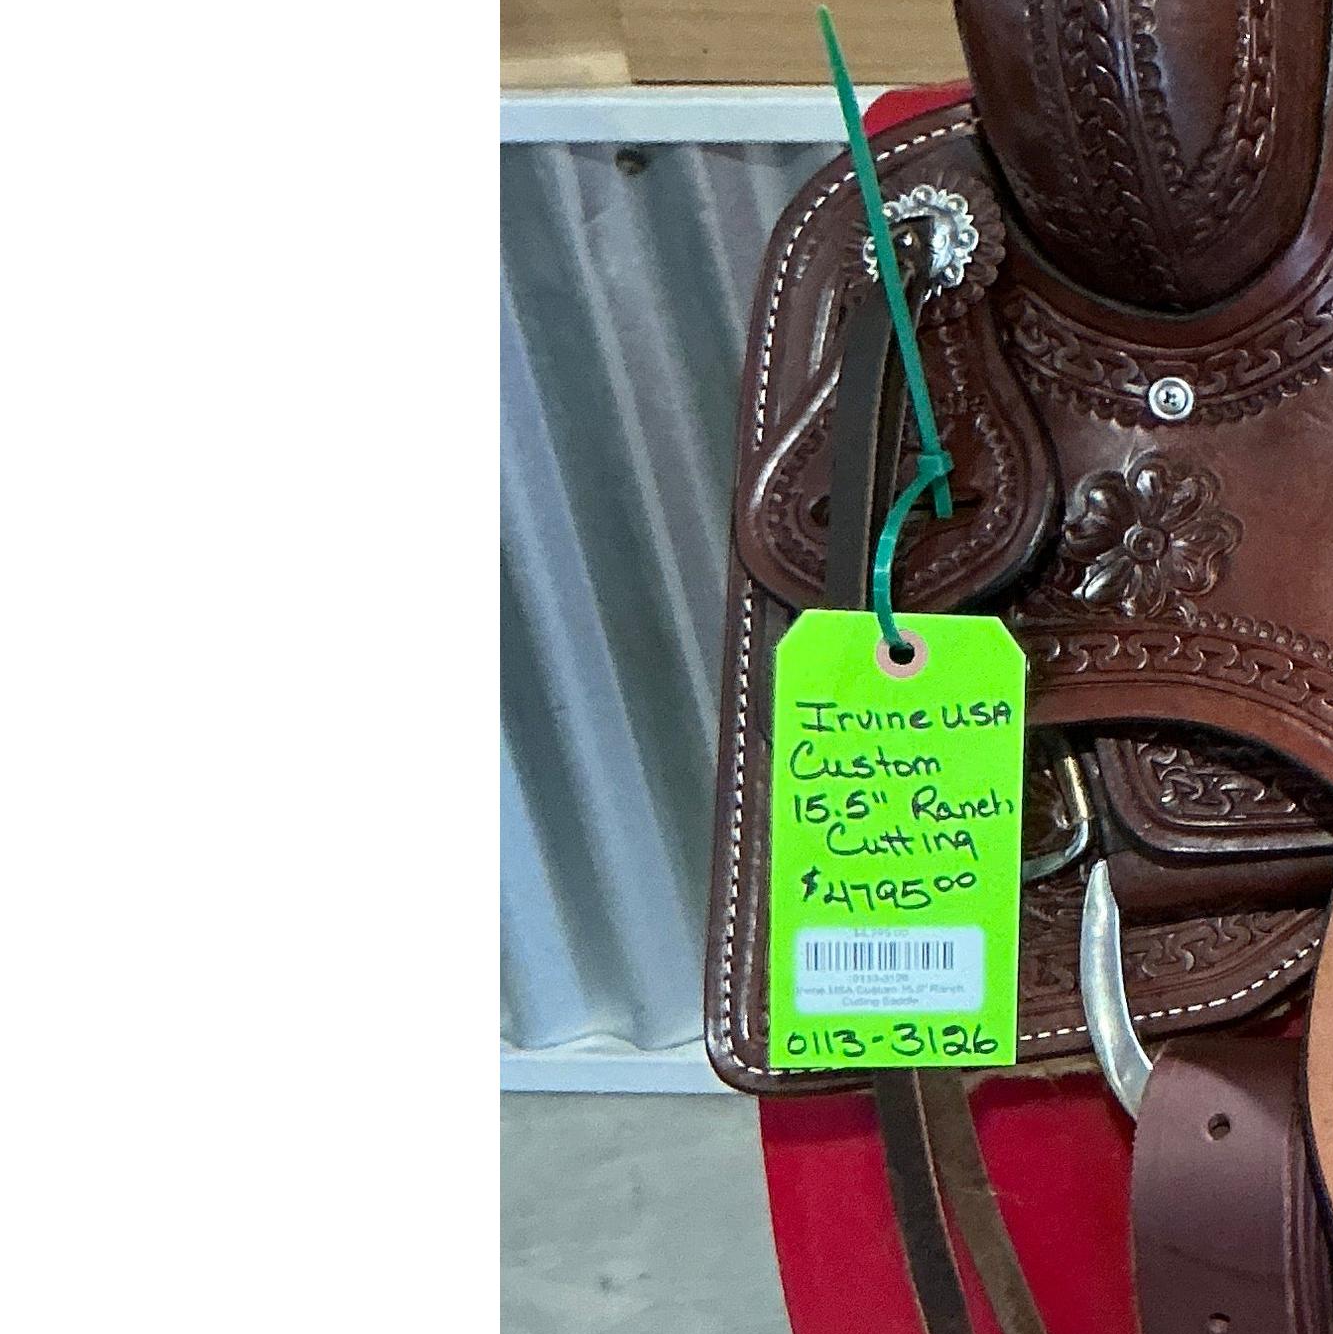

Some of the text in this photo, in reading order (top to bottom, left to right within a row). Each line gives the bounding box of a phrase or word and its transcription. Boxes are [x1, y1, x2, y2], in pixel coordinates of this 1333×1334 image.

[795, 700, 1013, 733] Irvine USA
[789, 739, 942, 781] Custom
[793, 785, 1015, 824] 15.5" Ranch
[826, 821, 979, 861] Cutting
[787, 1022, 999, 1058] 0113-3126
